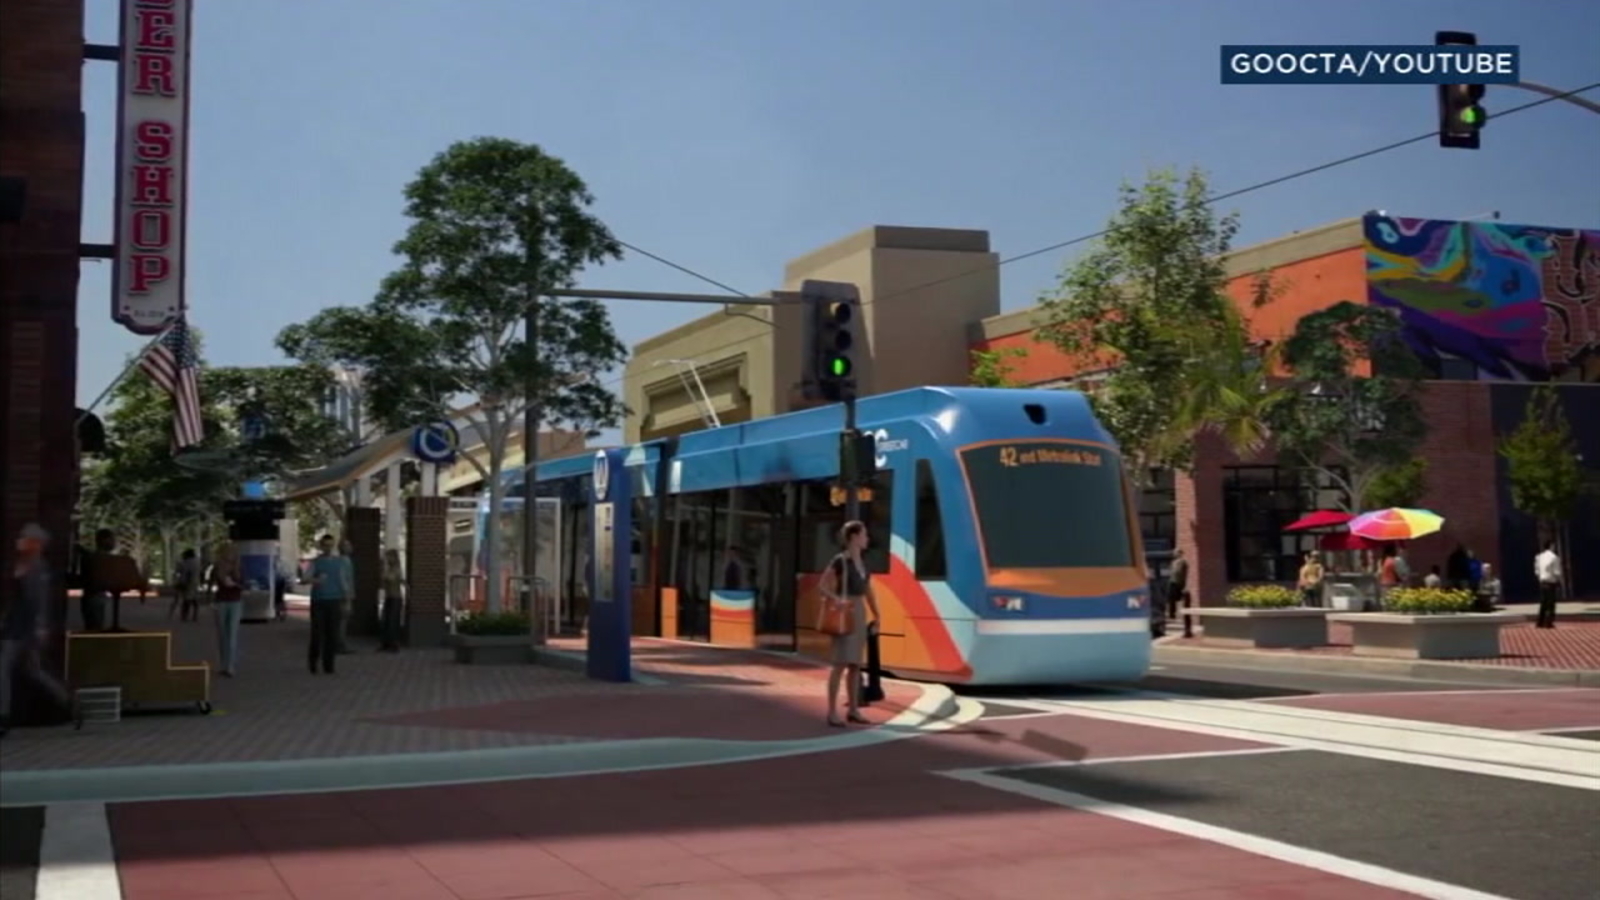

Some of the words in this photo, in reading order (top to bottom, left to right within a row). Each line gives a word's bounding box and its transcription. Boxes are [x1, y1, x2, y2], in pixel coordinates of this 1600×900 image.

[136, 0, 176, 96] ER
[129, 120, 174, 296] SHOP
[1000, 446, 1019, 466] 42
